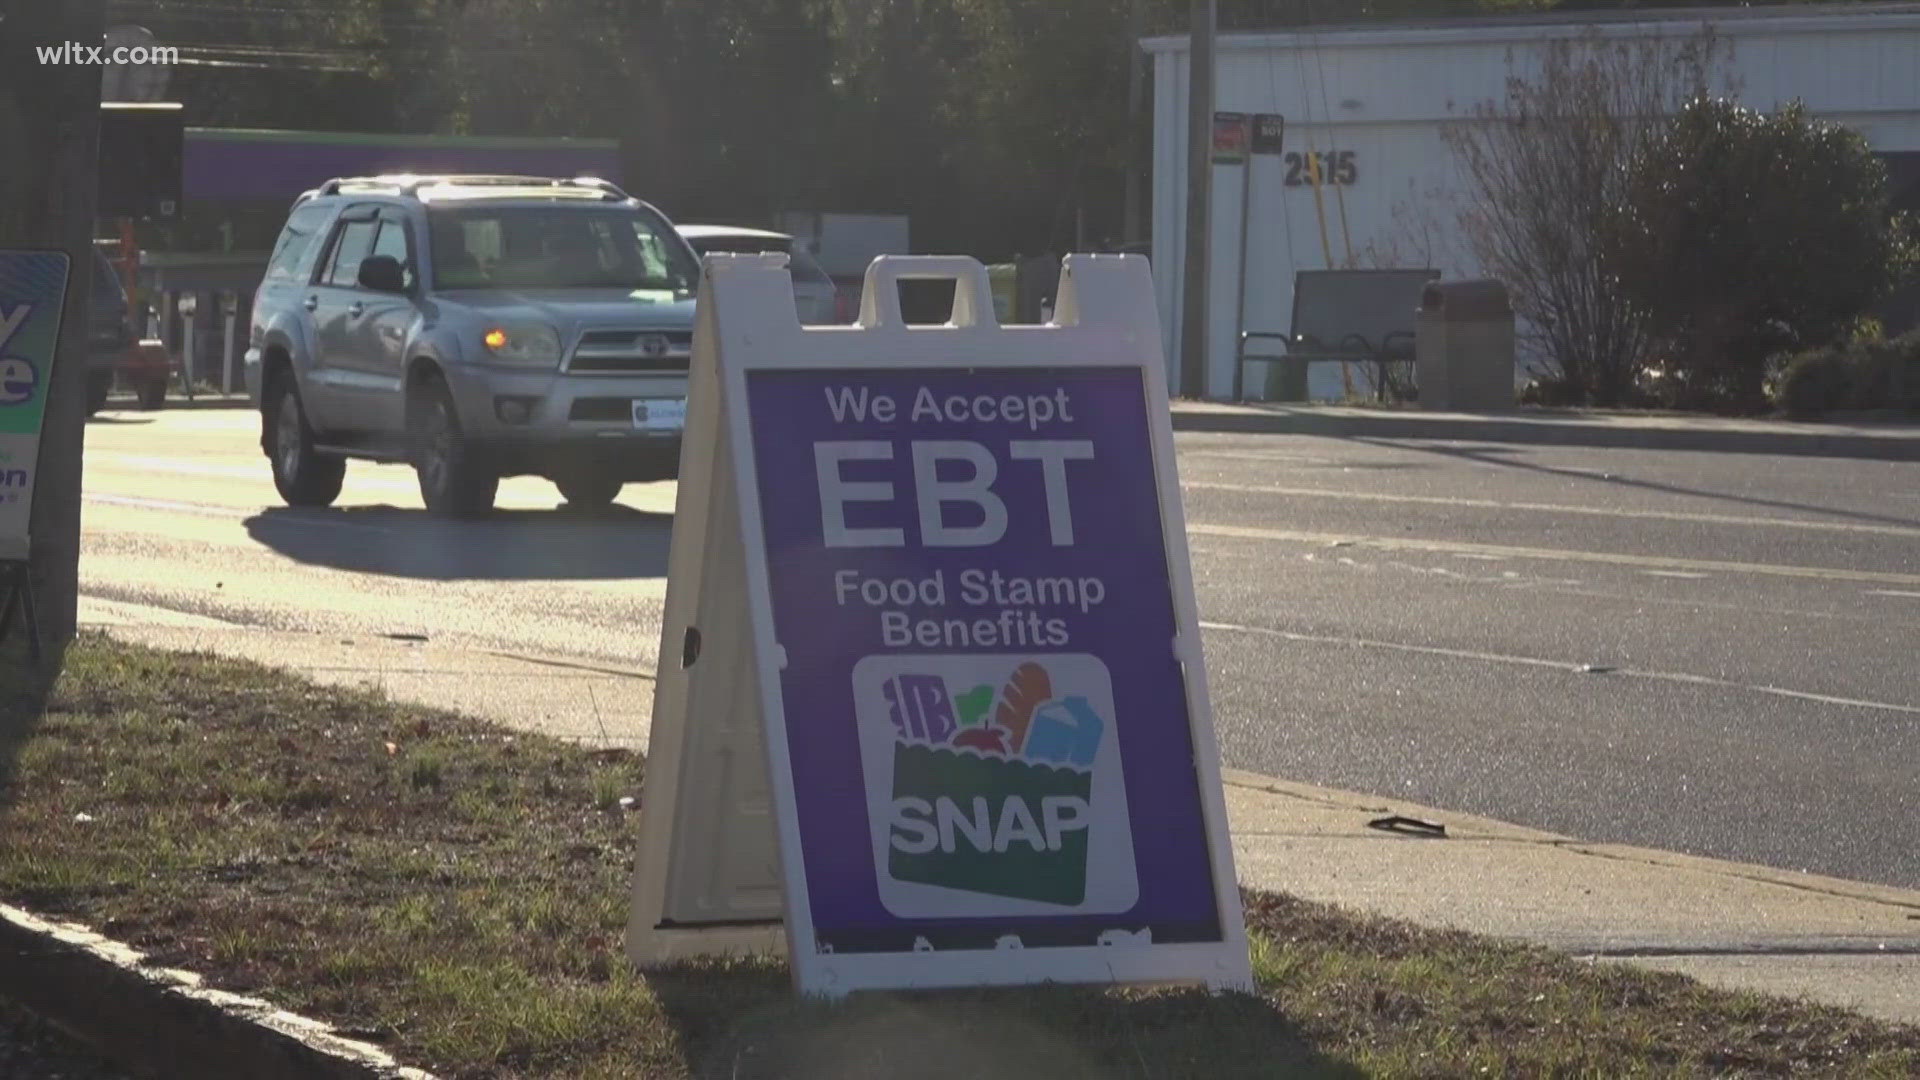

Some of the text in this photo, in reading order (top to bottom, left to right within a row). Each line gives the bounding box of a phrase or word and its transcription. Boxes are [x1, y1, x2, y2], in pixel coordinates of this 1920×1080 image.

[1285, 152, 1357, 185] 2515
[825, 387, 1074, 430] We Accept
[813, 440, 1095, 548] EBT
[834, 568, 1106, 613] Food Stamp
[881, 611, 1070, 648] Benefits
[890, 795, 1089, 854] SNAP
